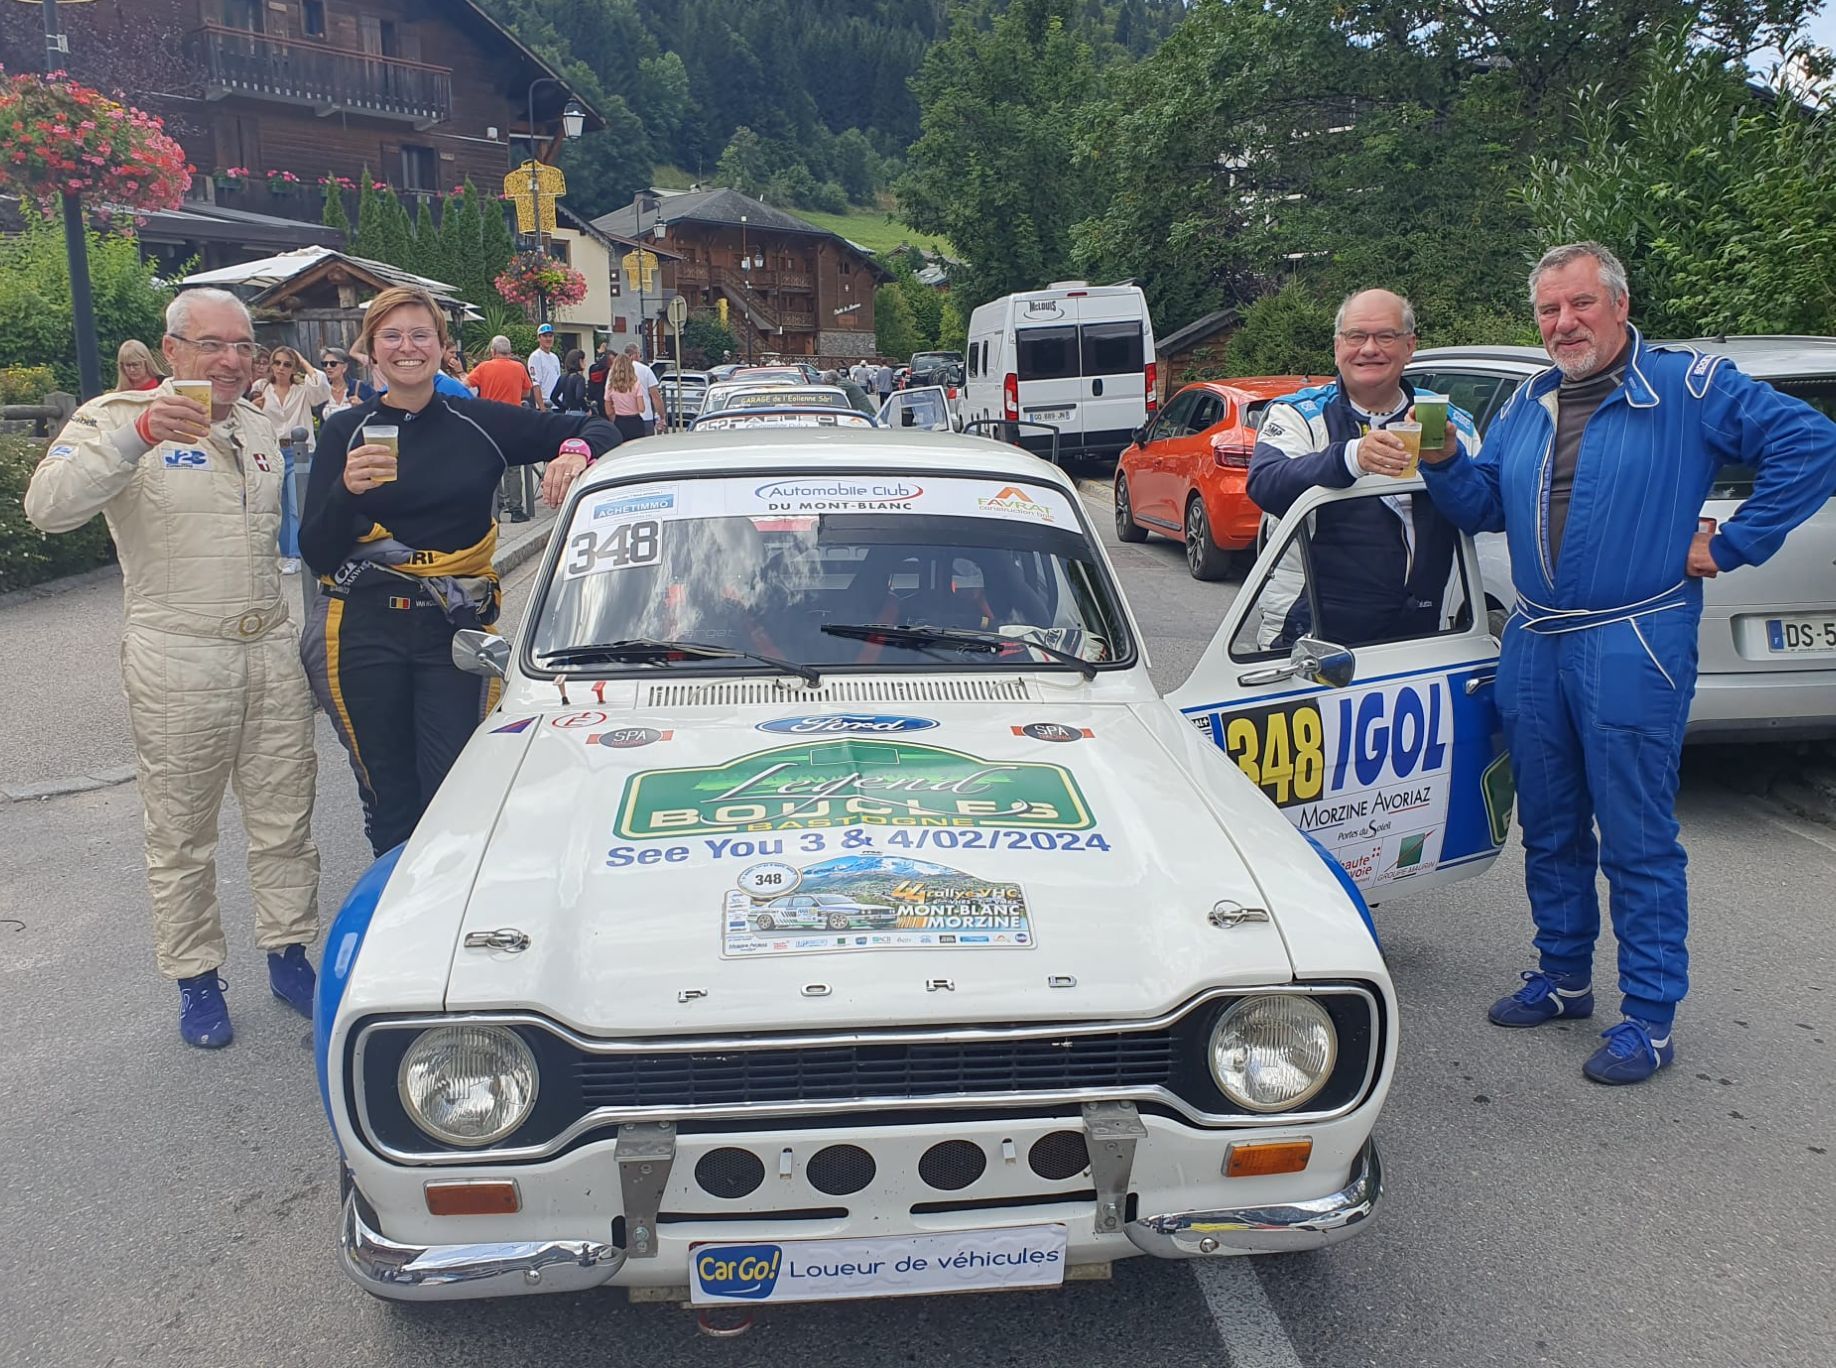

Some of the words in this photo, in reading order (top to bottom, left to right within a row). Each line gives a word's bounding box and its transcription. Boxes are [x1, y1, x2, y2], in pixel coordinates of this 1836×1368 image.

[741, 395, 770, 404] GARAGE
[769, 483, 868, 497] Automobile
[873, 483, 910, 496] Club
[599, 501, 668, 518] ACHETIMMO
[768, 503, 792, 511] DU
[799, 501, 912, 511] MONT-BLANC
[978, 497, 1053, 518] FAVRAT
[568, 521, 659, 575] 348
[791, 714, 905, 732] Ford
[1034, 724, 1071, 737] SPA
[613, 730, 647, 742] SPA
[1331, 683, 1447, 792] IGOL
[1227, 706, 1324, 804] 348
[700, 763, 1018, 815] Legend
[650, 799, 1060, 828] BOUCLES
[1300, 801, 1368, 829] MORZINE
[1371, 787, 1431, 814] AVORIAZ
[747, 816, 976, 833] BASTOGNE
[1337, 830, 1358, 841] Portes
[606, 846, 690, 868] See
[704, 838, 783, 859] You
[799, 833, 826, 852] 3
[841, 828, 873, 848] &
[887, 829, 1112, 851] 4/02/2024
[755, 873, 782, 886] 348
[892, 880, 926, 904] 44
[927, 888, 977, 900] rallye
[979, 888, 1018, 898] VHC
[897, 904, 1020, 916] MONT-BLANC
[927, 916, 1020, 929] MORZINE
[678, 974, 1078, 1004] FORD
[789, 1259, 886, 1279] Loueur
[895, 1256, 928, 1273] de
[937, 1247, 1060, 1270] véhicules
